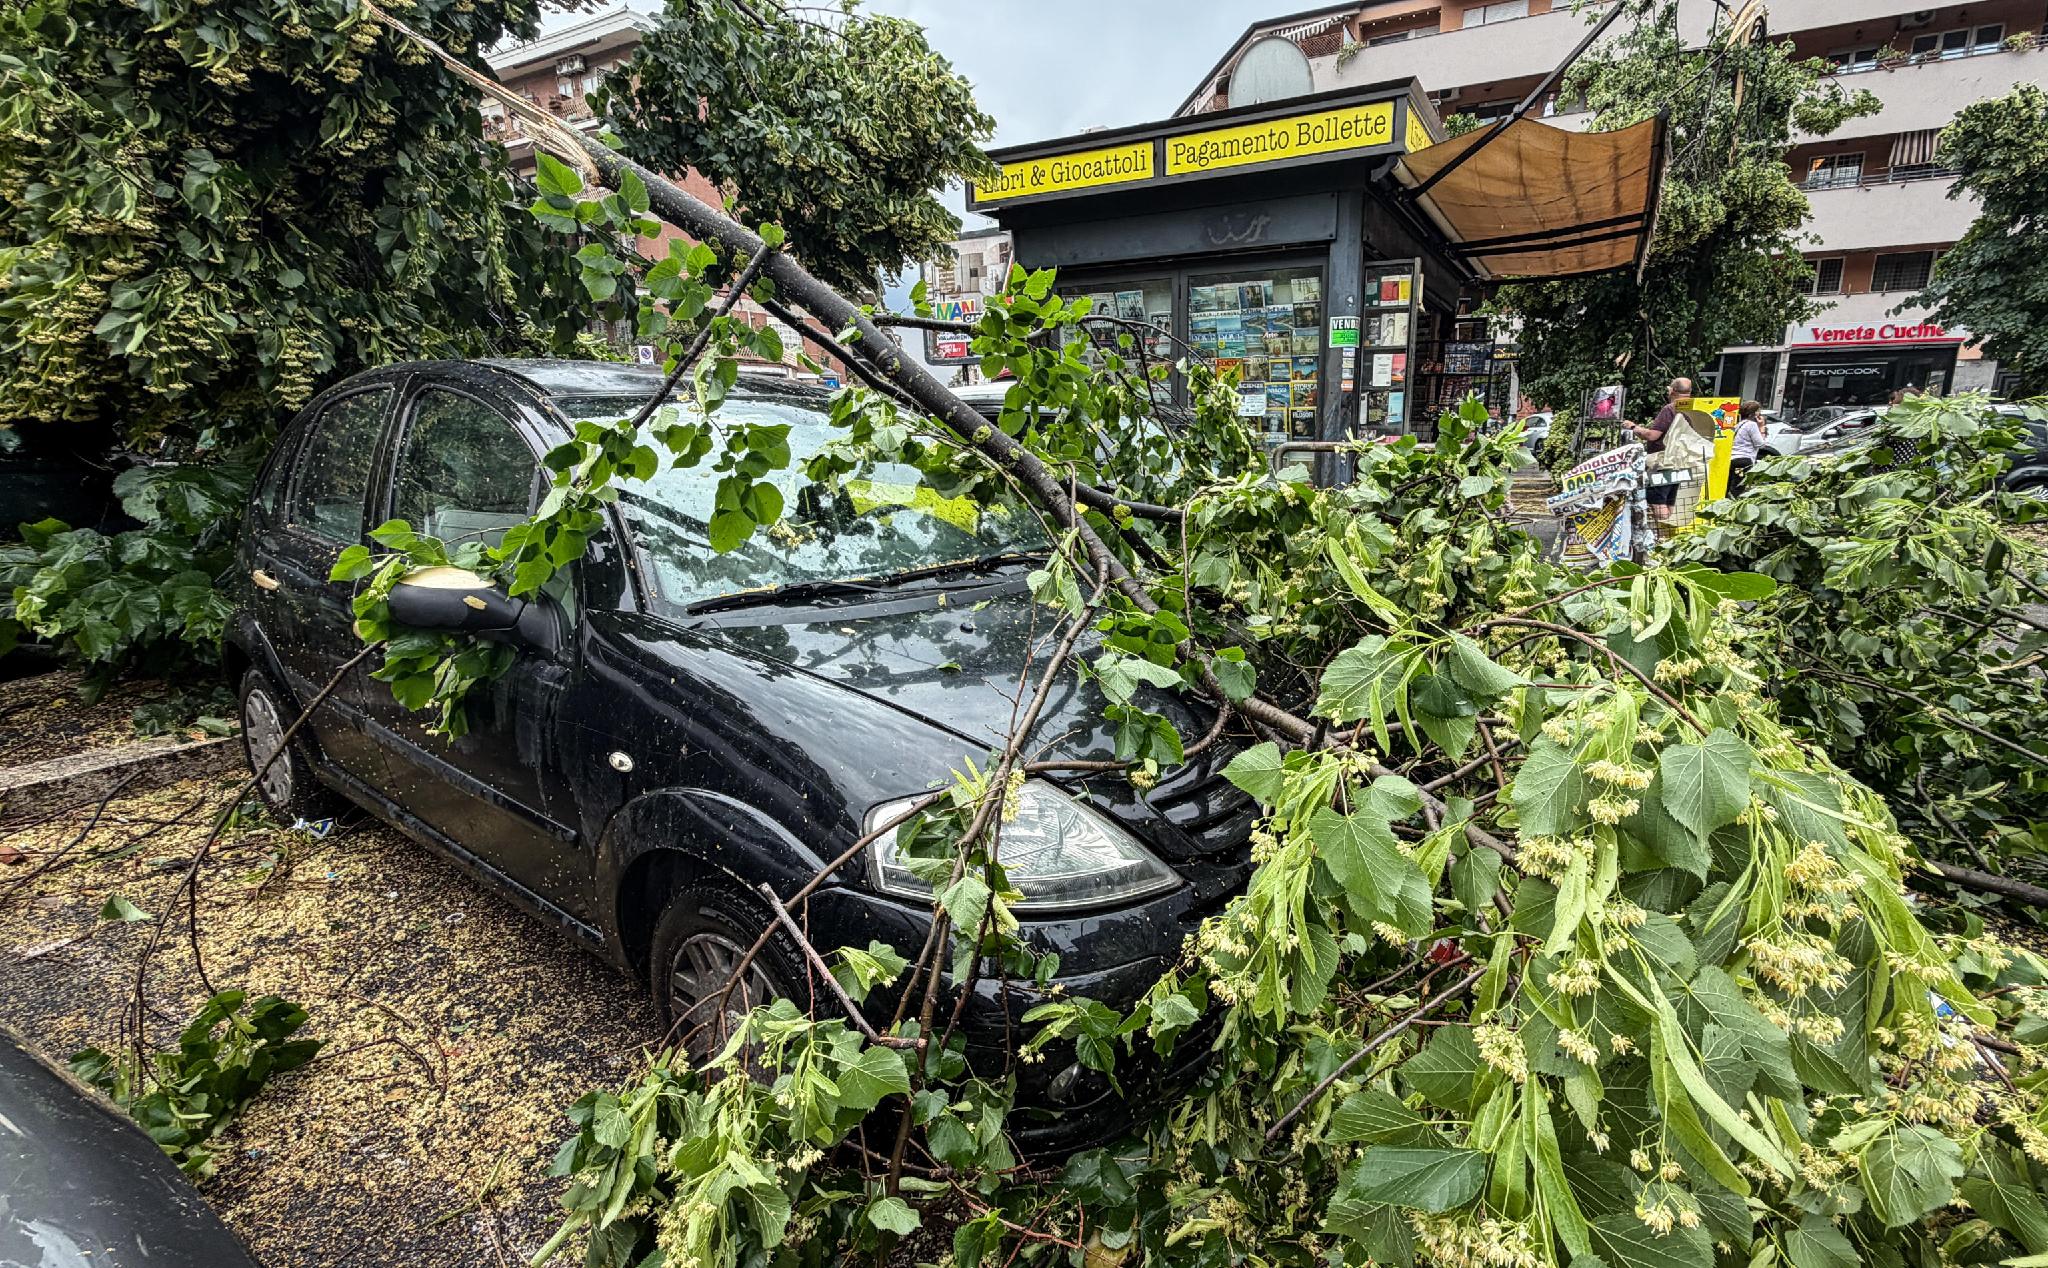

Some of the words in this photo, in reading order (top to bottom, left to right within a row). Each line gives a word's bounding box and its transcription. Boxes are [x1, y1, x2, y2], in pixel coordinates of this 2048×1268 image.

[1173, 128, 1290, 168] Pagamento
[1295, 112, 1386, 147] Bollette
[1030, 165, 1046, 187] &
[1051, 149, 1147, 184] Giocattoli
[1811, 327, 1876, 342] Veneta
[1879, 323, 1946, 340] Cucine
[1801, 367, 1881, 376] TEKNOCOOK
